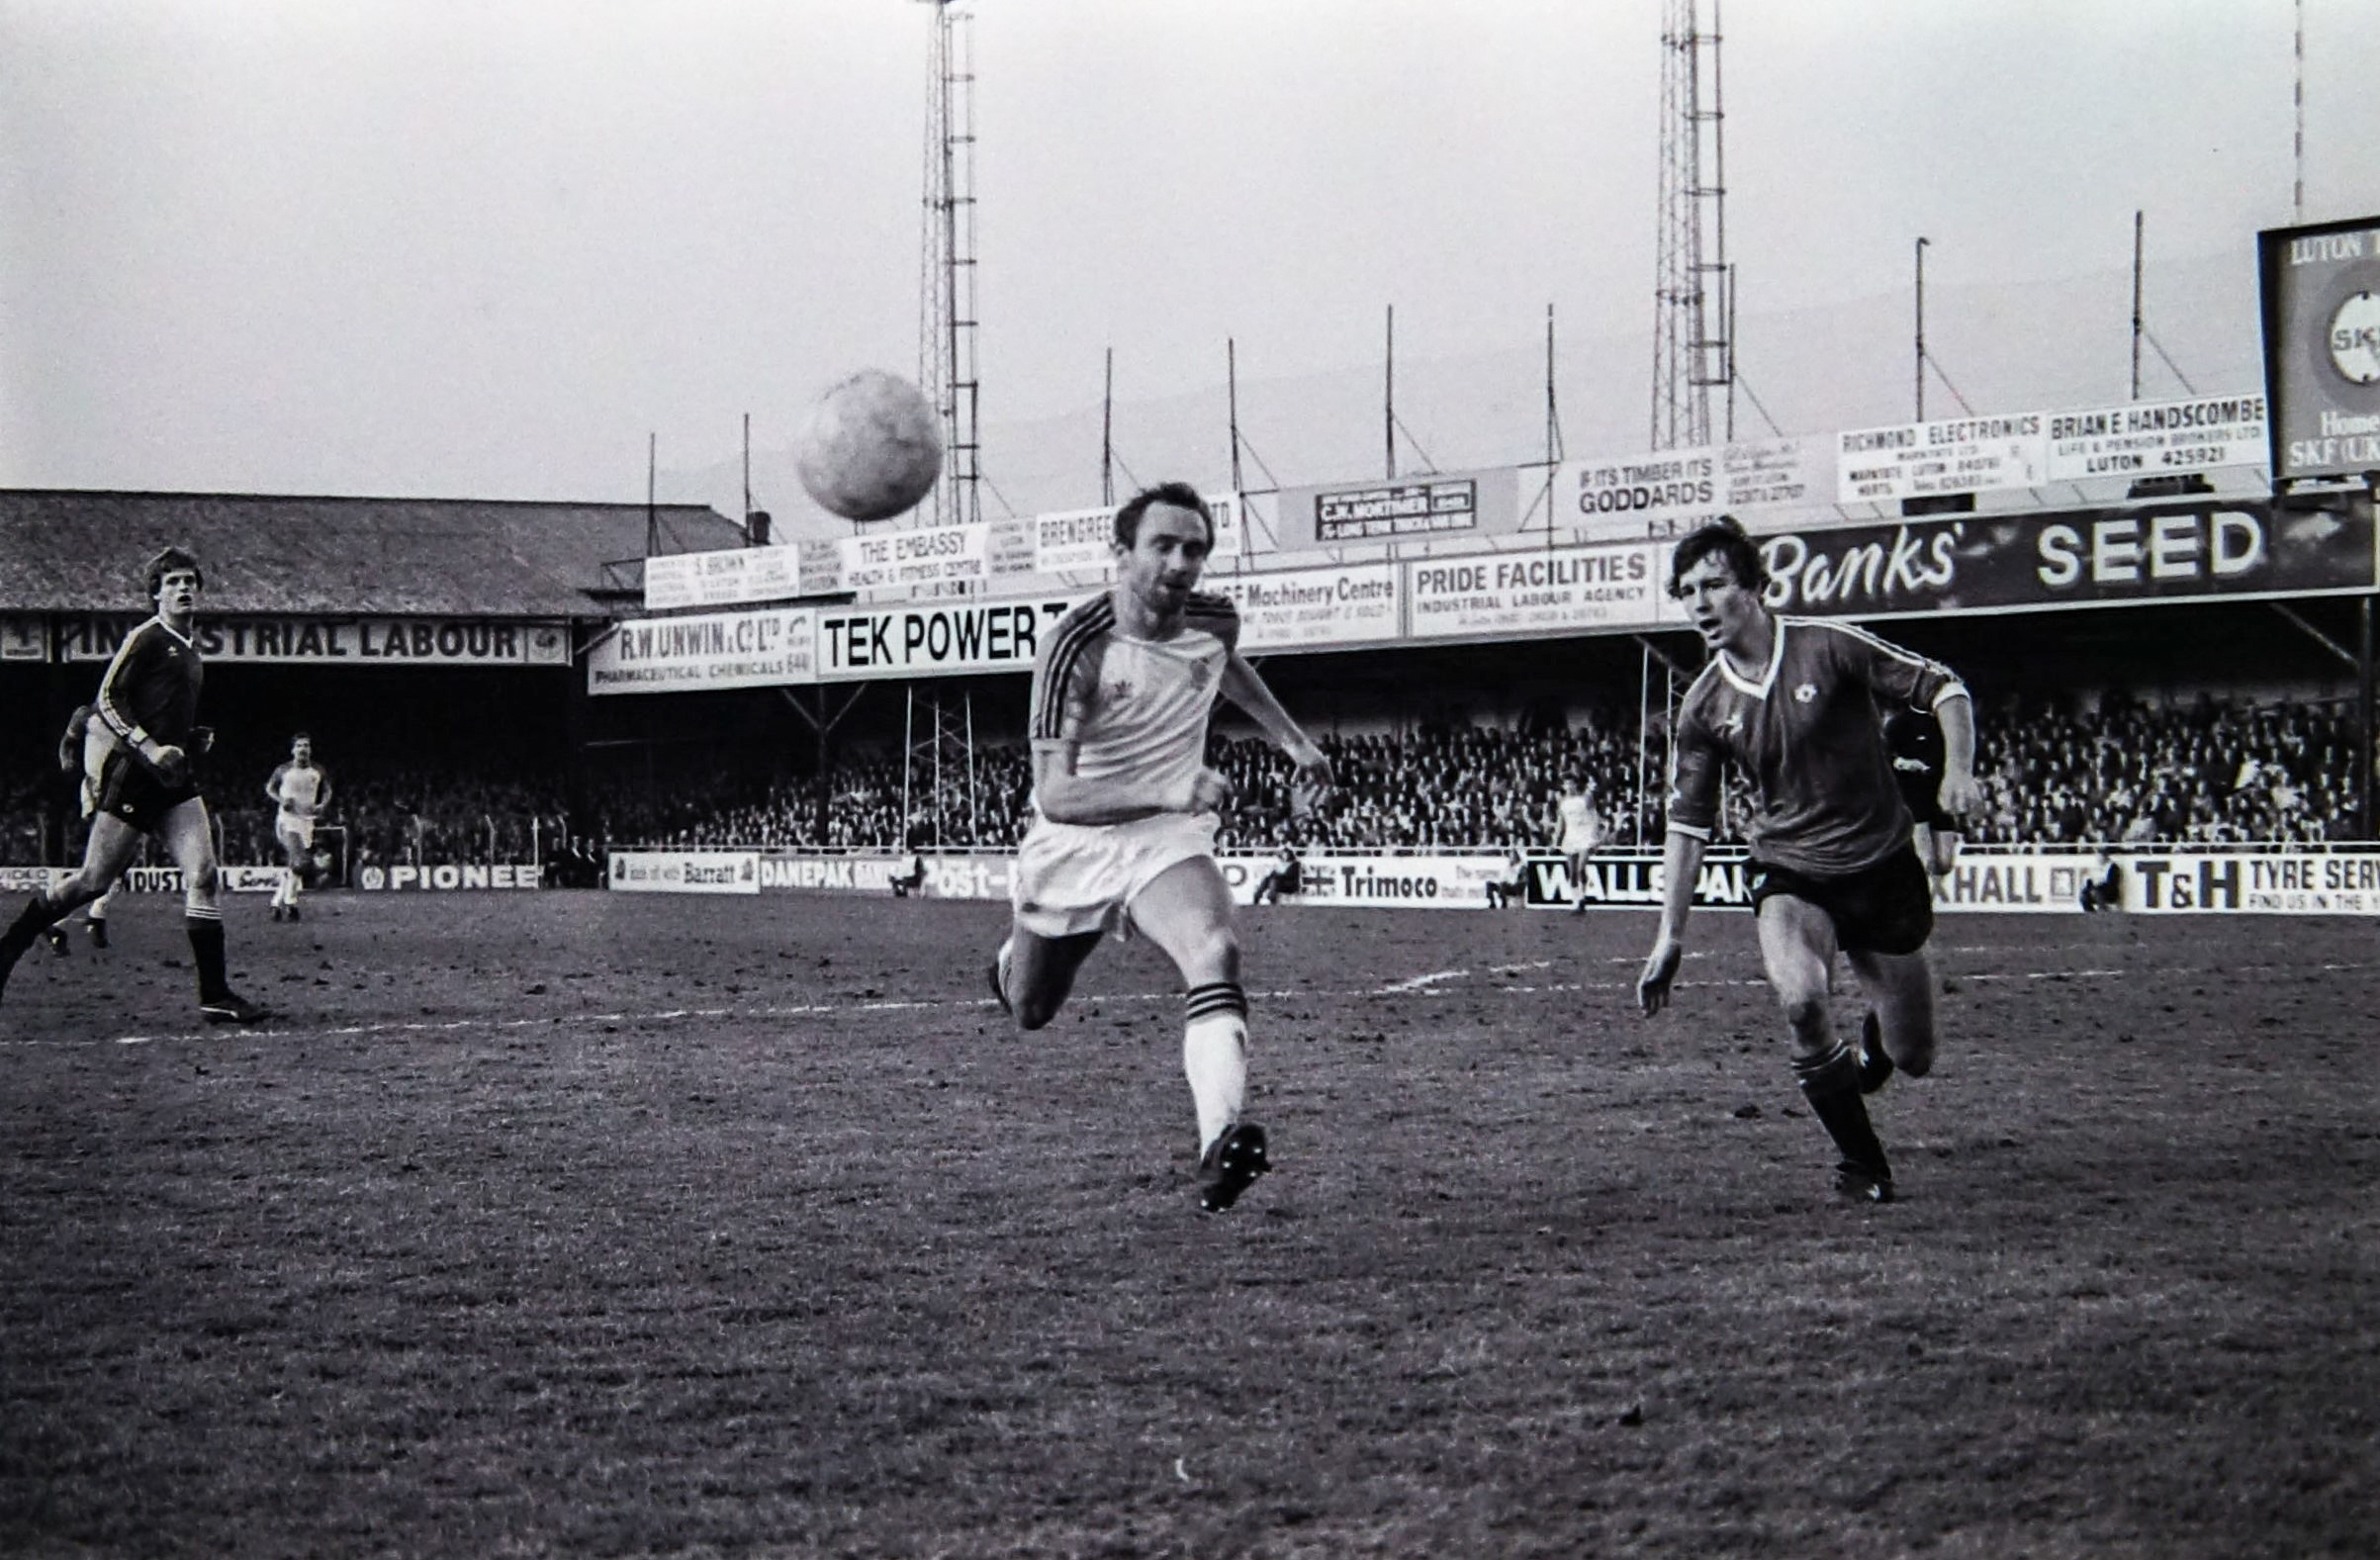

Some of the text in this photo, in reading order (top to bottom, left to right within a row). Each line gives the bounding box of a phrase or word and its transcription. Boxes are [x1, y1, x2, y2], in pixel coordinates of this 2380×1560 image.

[2291, 236, 2362, 264] LUTON
[2128, 398, 2264, 431] HANDSCOMBE
[1843, 415, 2041, 453] RICHMOND ELECTRONICS
[2086, 446, 2226, 473] LUTON 425921
[2289, 438, 2338, 467] SKF
[1623, 462, 1683, 484] TIMBER
[1687, 458, 1713, 478] ITS
[1580, 481, 1714, 513] GODDARDS
[861, 531, 966, 563] THE EMBASSY
[1763, 510, 2265, 608] Banks' SEED
[1418, 553, 1646, 595] PRIDE FACILITIES
[1247, 582, 1334, 606] Machinery
[1337, 576, 1394, 601] Centre
[1418, 586, 1646, 613] INDUSTRIAL LABOUR AGENCY
[81, 621, 518, 658] INSTRIAL LABOUR
[824, 614, 893, 668] TEK
[595, 664, 701, 685] PHARMACEUTICAL
[709, 660, 783, 679] CHEMICALS
[390, 865, 544, 890] PIONEE
[685, 862, 736, 884] Barratt
[762, 859, 854, 889] DANEPAK
[1340, 865, 1438, 899] Trimoco
[1932, 865, 2043, 904] XHALL
[2135, 860, 2241, 909] T&H
[2250, 859, 2316, 890] TYRE
[2335, 892, 2363, 911] THE
